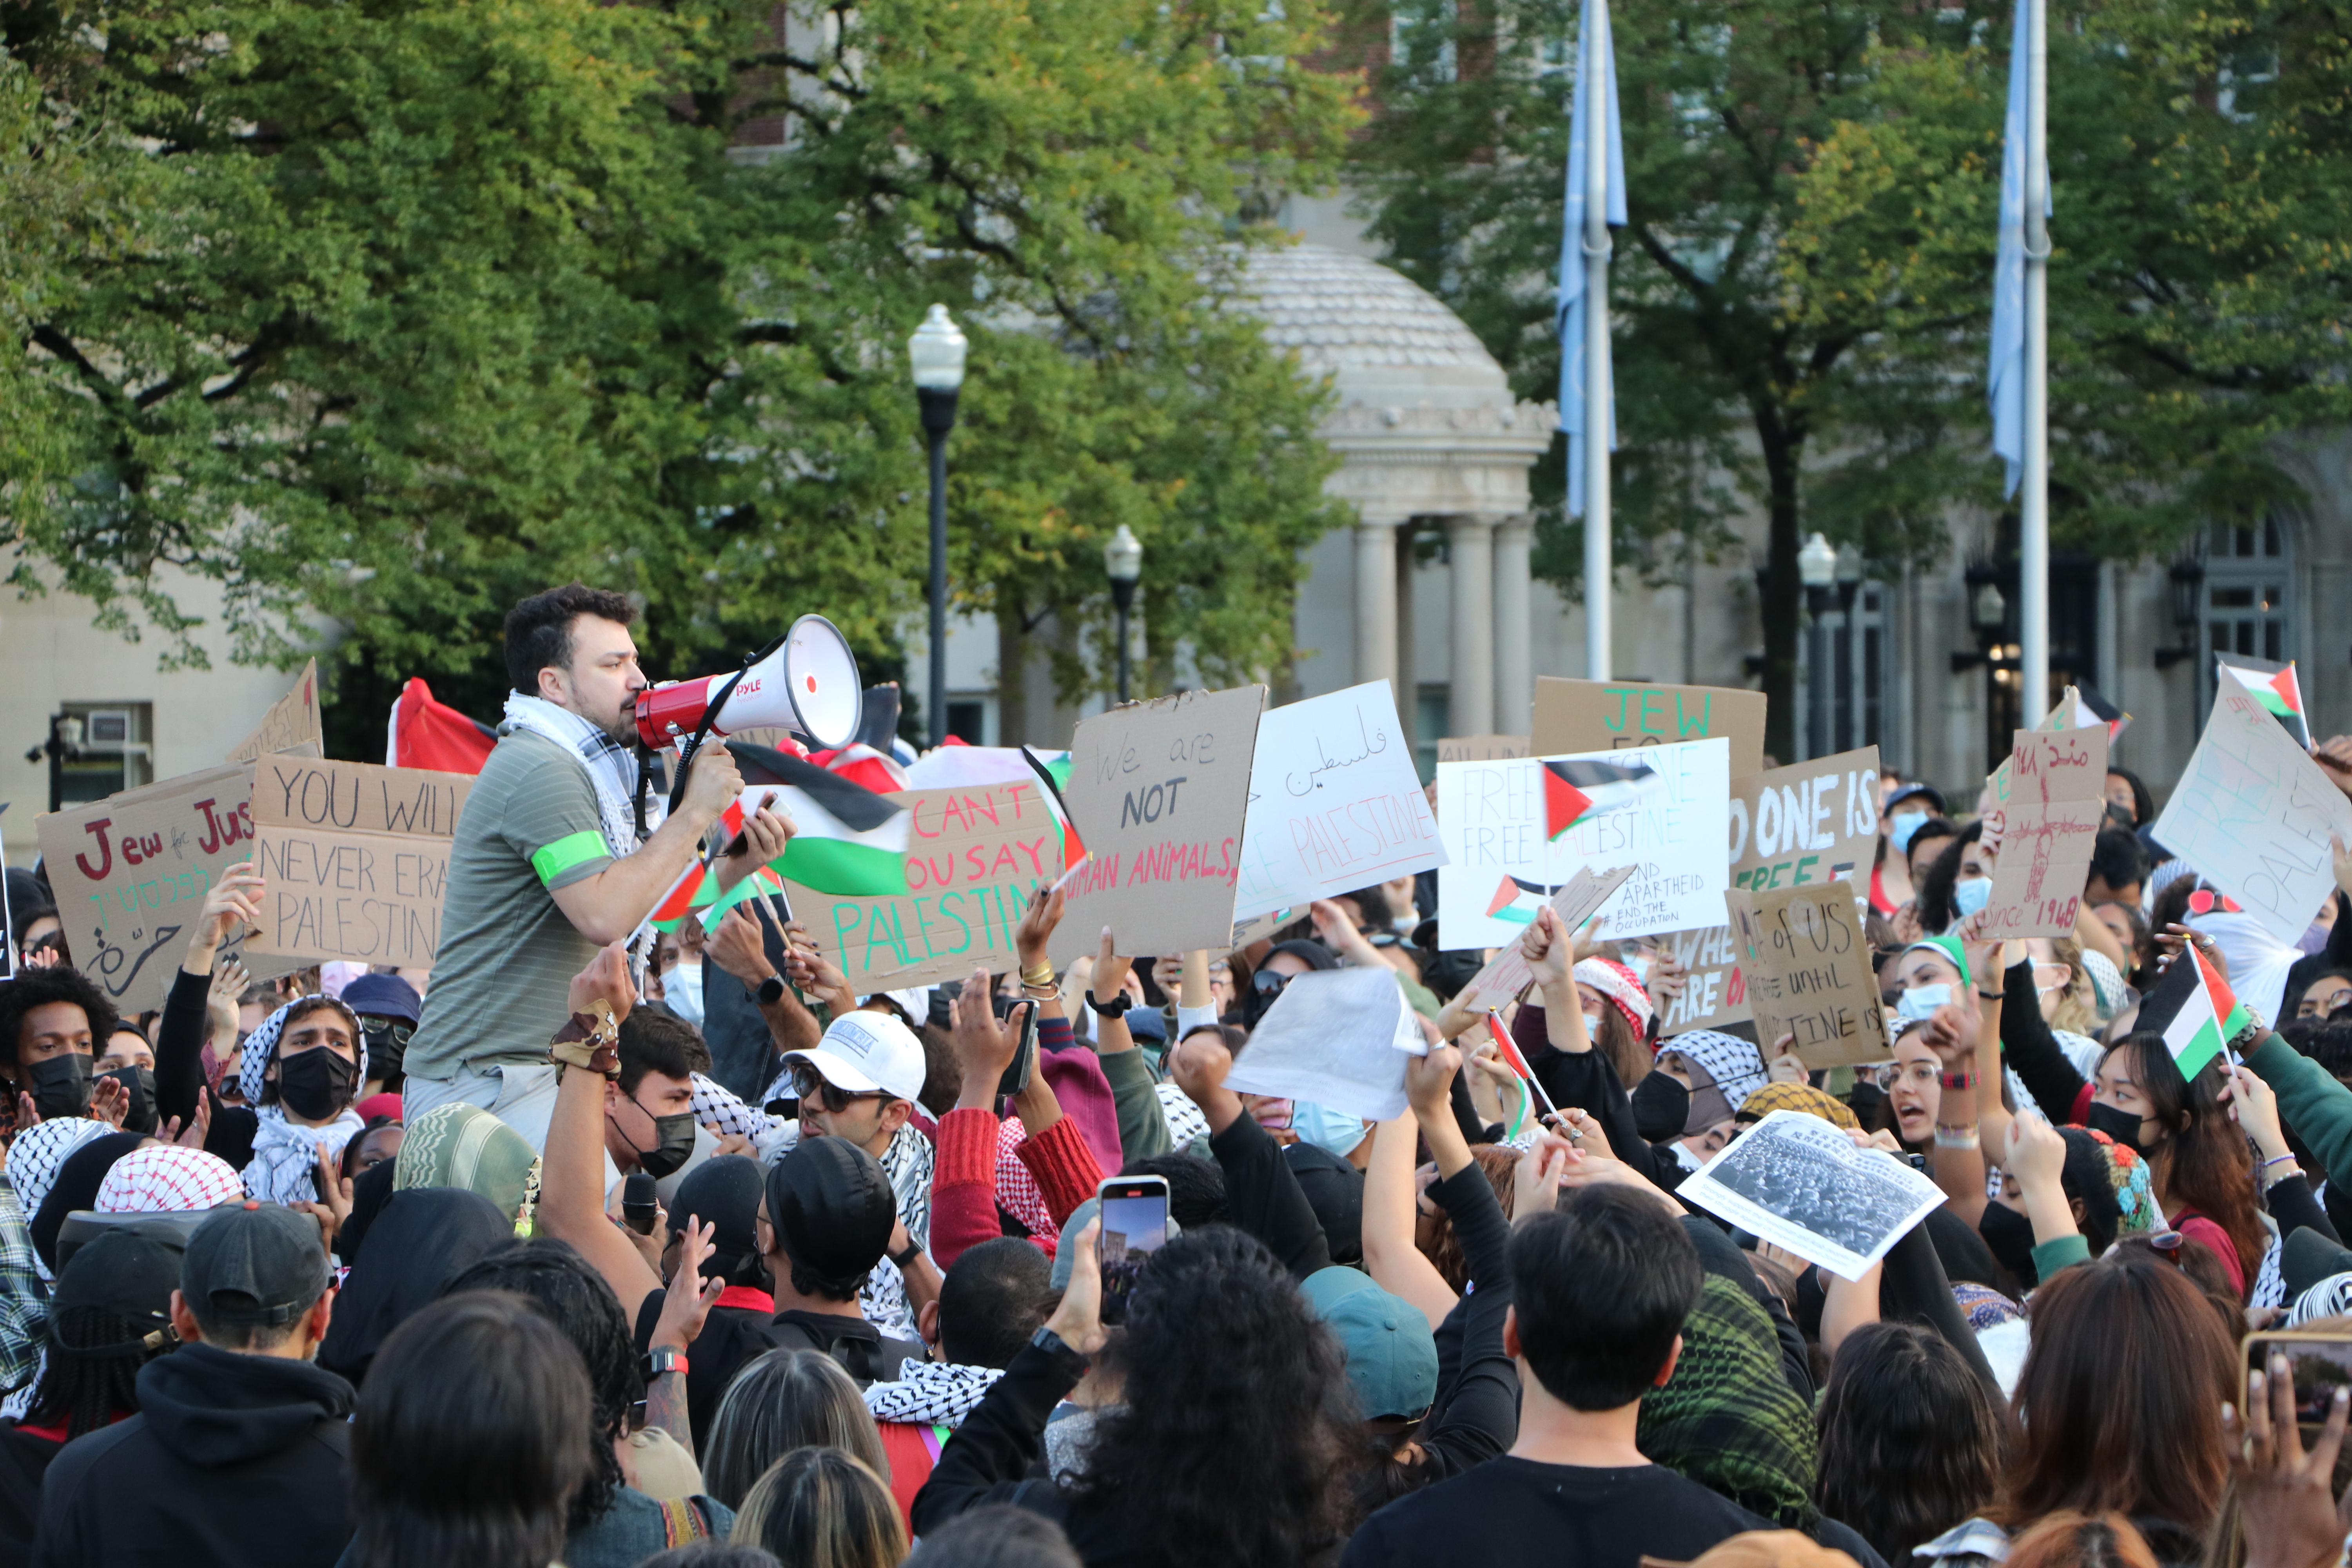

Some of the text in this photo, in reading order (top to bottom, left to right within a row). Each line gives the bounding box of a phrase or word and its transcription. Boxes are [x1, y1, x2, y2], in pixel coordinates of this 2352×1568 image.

[736, 679, 761, 697] PYLE
[1604, 689, 1711, 737] JEW
[1097, 731, 1214, 784] We are
[1286, 704, 1387, 797] فلسطين
[274, 765, 455, 835] YOU WILL
[913, 784, 1030, 838] CAN'T
[1121, 776, 1187, 829] NOT
[1463, 764, 1536, 824] FREE
[1729, 769, 1877, 865] O ONE IS
[2164, 722, 2279, 885] FREE
[75, 817, 163, 881] Jew
[194, 790, 254, 855] Jus
[904, 835, 1045, 890] OU SAY
[1289, 791, 1435, 876] PALESTINE
[1463, 807, 1685, 867] FREE ALESTINE
[259, 838, 376, 893] NEVER
[396, 853, 447, 899] ERA
[1238, 831, 1287, 897] EE
[1622, 874, 1704, 905] APARTHEID
[278, 892, 436, 961] PALESTIN
[832, 877, 1051, 979] PALESTIN
[1615, 911, 1679, 933] OCCUPATION
[1617, 906, 1641, 921] END
[1644, 901, 1666, 915] THE
[1773, 908, 1796, 958] of
[1807, 903, 1850, 954] US
[1984, 895, 2078, 929] Since 1948
[1674, 926, 1736, 970] WHE
[1665, 965, 1746, 1028] ARE O
